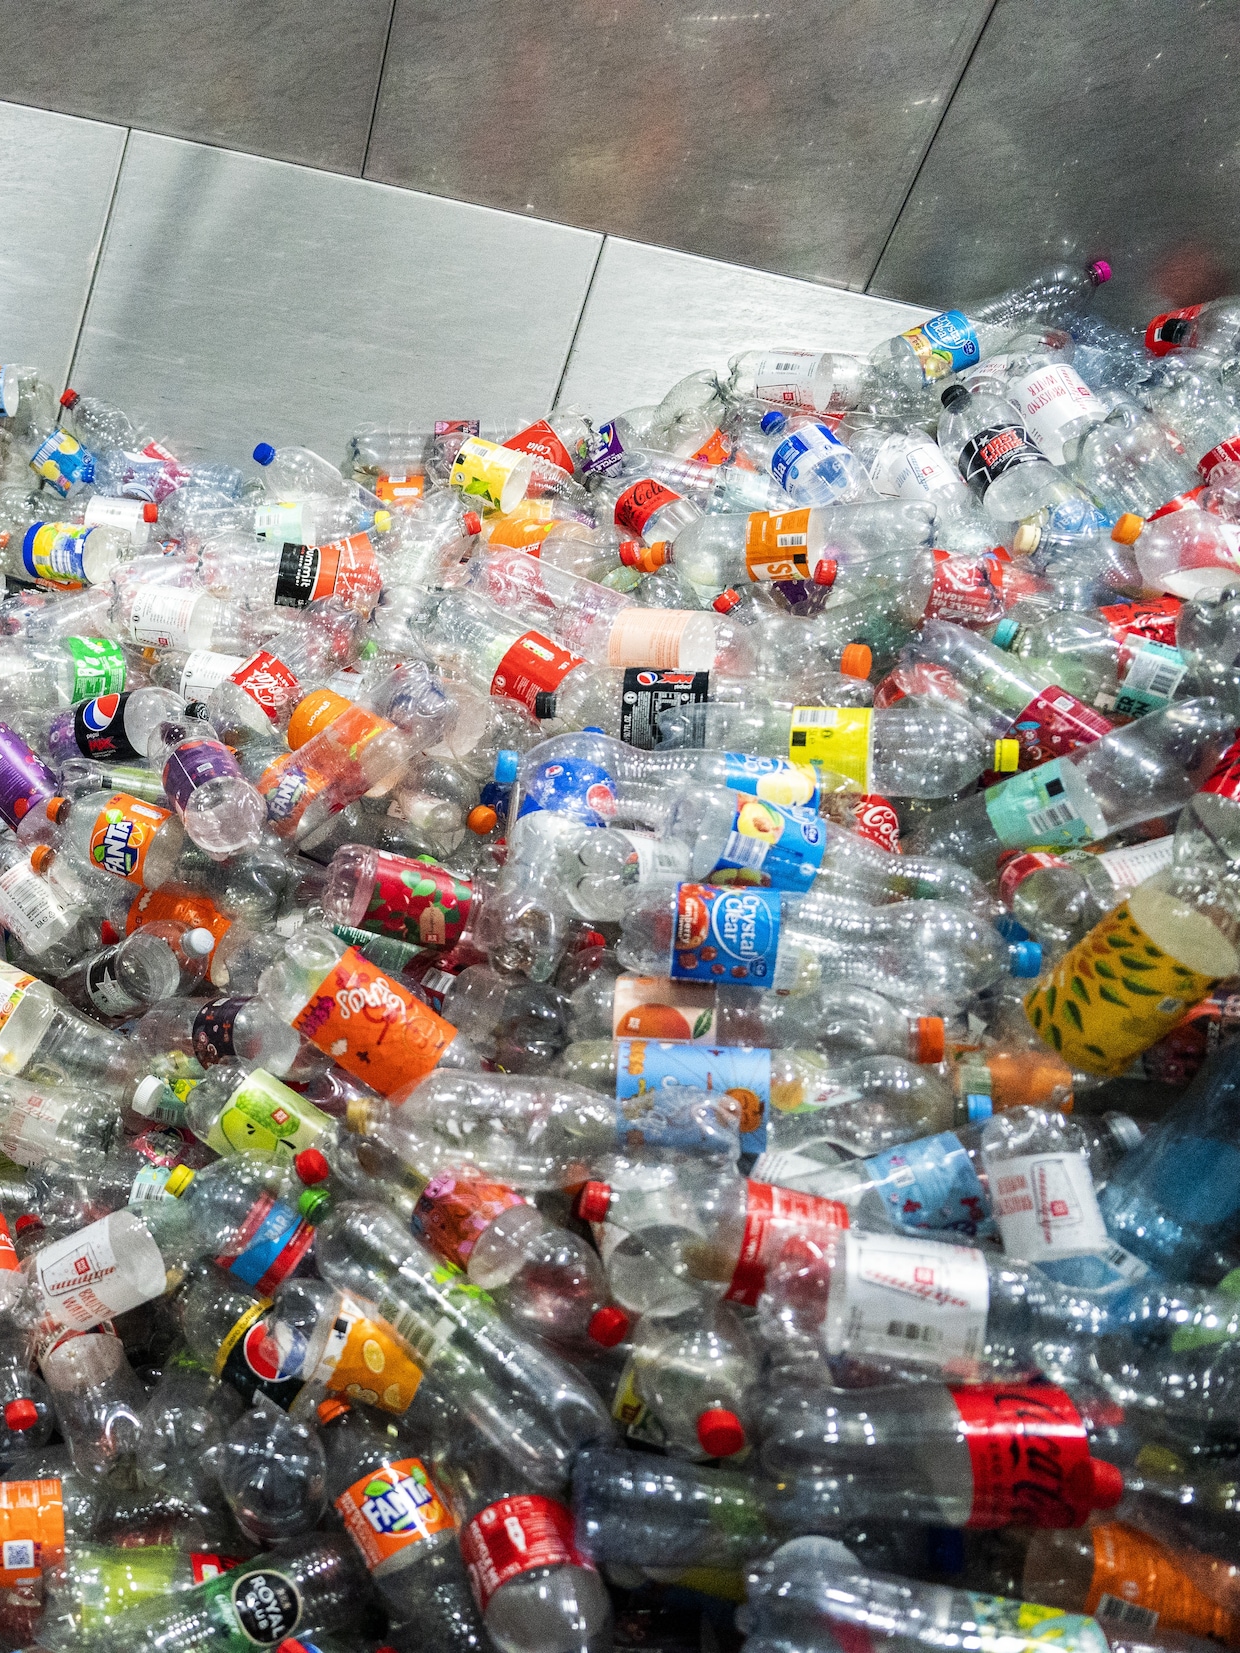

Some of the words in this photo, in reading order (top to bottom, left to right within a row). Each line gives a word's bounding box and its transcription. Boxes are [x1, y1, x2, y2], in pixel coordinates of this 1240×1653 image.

[940, 314, 965, 345] Crystal
[526, 442, 551, 455] Cola
[306, 700, 331, 727] gwoon
[106, 819, 133, 877] FANTA
[723, 899, 738, 944] Clear
[740, 893, 758, 958] Crystal
[62, 1296, 93, 1322] WATER
[249, 1576, 286, 1639] ROYAL
